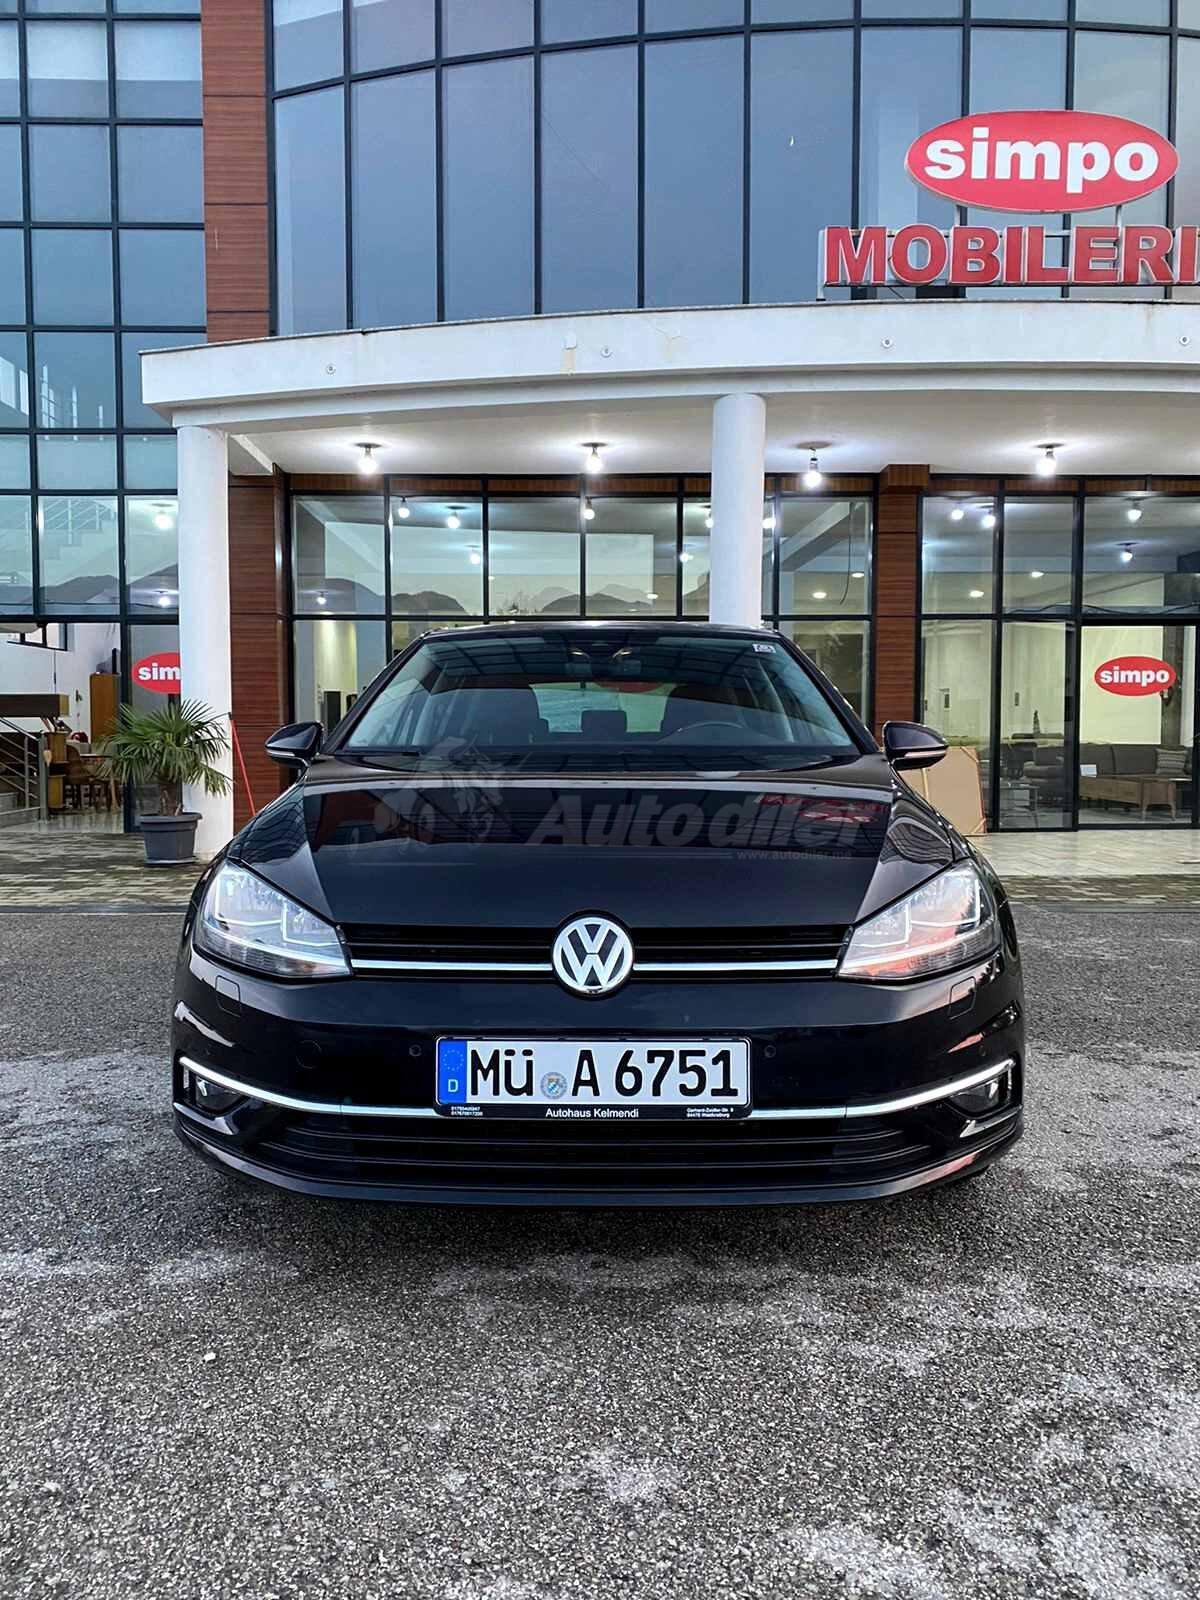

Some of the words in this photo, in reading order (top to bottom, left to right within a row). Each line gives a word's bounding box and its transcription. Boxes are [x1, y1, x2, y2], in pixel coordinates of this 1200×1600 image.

[924, 127, 1159, 193] simpo
[824, 224, 1199, 285] MOBILERI
[1100, 666, 1170, 687] simpo
[553, 917, 633, 993] VW
[447, 1079, 458, 1093] D
[571, 1049, 600, 1097] A
[615, 1049, 739, 1098] 6751
[545, 1107, 591, 1119] Autohaus
[593, 1107, 640, 1119] Kelmendi
